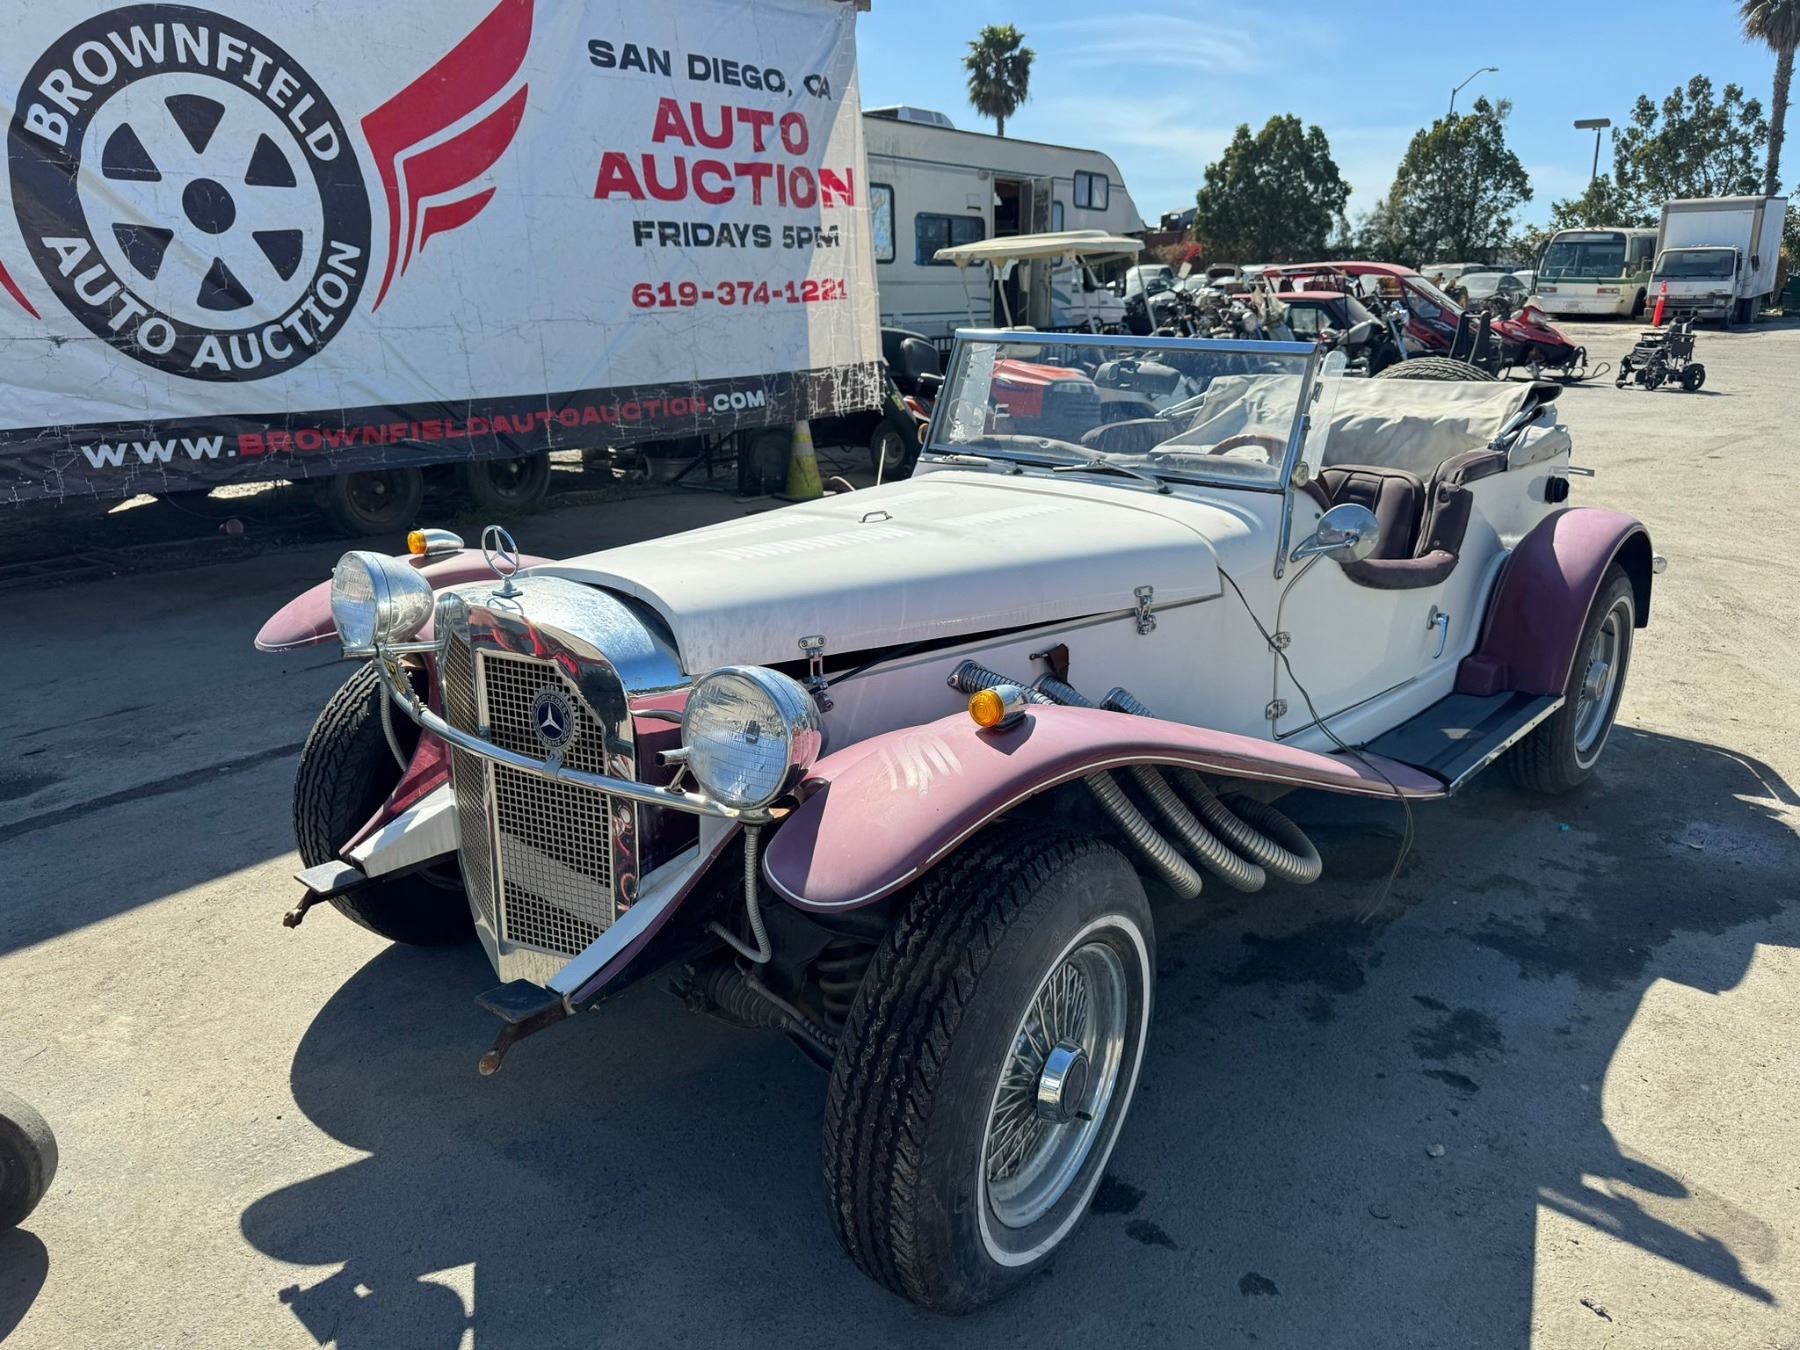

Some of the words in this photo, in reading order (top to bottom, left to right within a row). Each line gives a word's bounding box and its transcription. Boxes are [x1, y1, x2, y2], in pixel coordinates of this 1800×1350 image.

[23, 22, 340, 163] BROWNFIELD
[587, 39, 671, 77] SAN
[688, 53, 792, 98] DIEGO,
[803, 73, 832, 101] CA
[652, 96, 809, 156] AUTO
[594, 151, 855, 209] AUCTION
[632, 220, 772, 249] FRIDAYS
[782, 222, 841, 249] 5PM
[42, 236, 177, 355] AUTO
[190, 239, 361, 373] AUCTION
[632, 277, 848, 308] 619-374-1221
